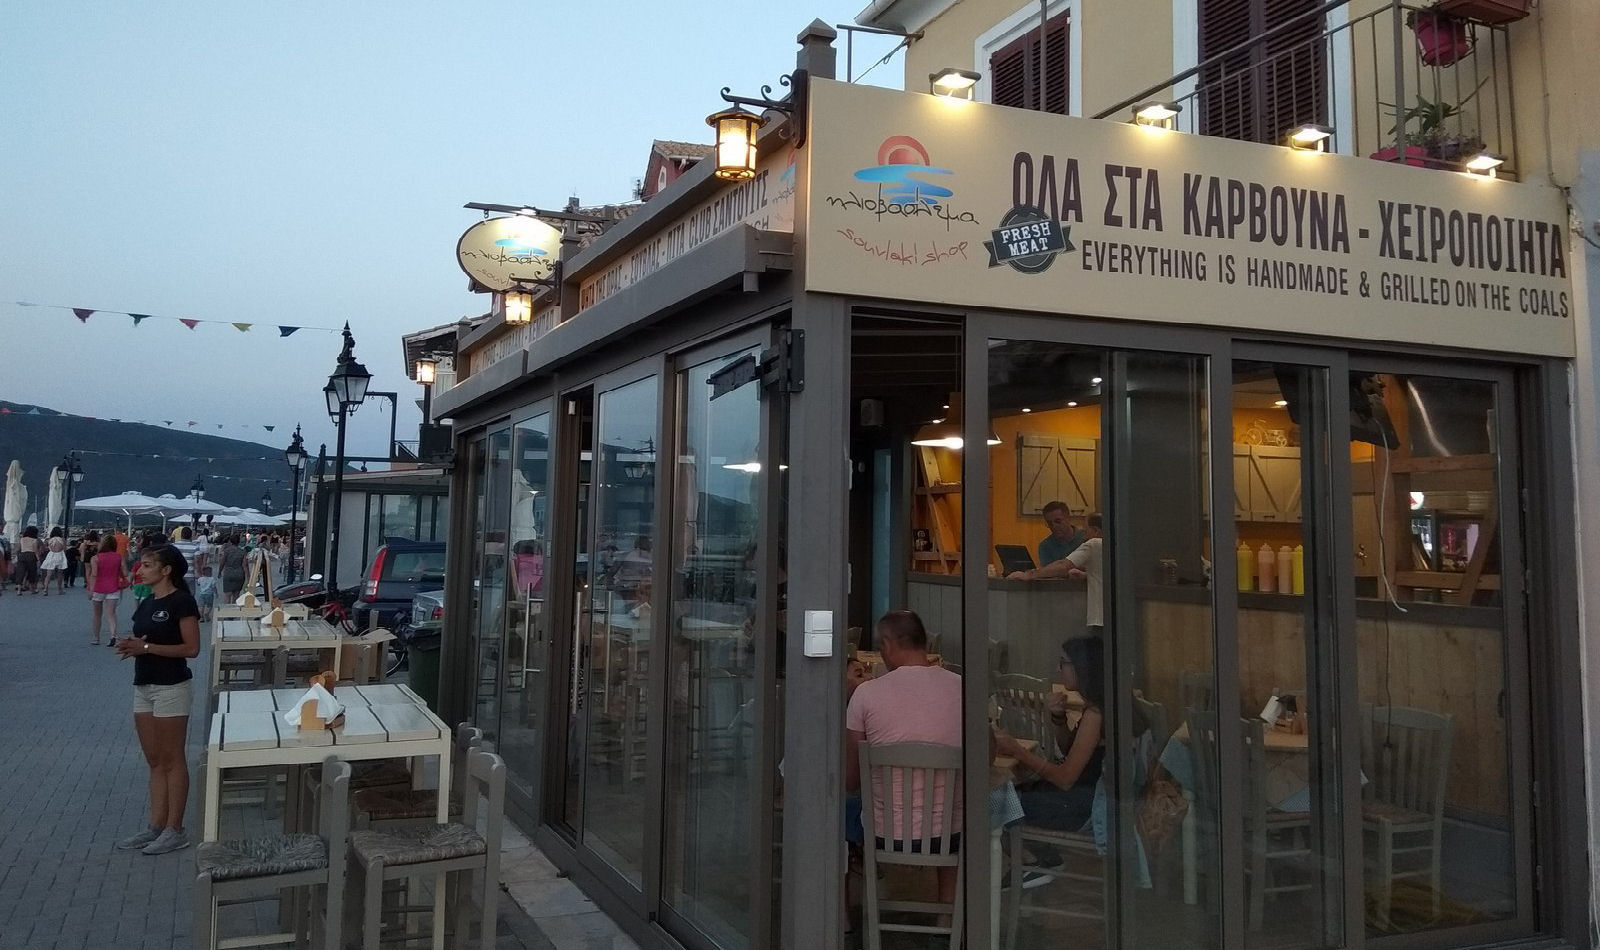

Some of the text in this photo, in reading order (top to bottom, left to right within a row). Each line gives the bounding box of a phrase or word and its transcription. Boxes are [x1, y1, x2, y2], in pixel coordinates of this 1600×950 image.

[1012, 151, 1084, 223] ΟΛΑ
[1104, 163, 1164, 232] ΣΤΑ
[1183, 172, 1351, 254] ΚΑΡΒΟΥΝΑ
[1378, 199, 1567, 279] ΧΕΙΡΟΠΟΙΗΤΑ
[1000, 221, 1052, 244] FRESH
[921, 240, 969, 266] shop
[1009, 236, 1050, 257] MEAT
[1082, 239, 1569, 318] EVERYTHING IS HANDMADE & GRILLED ON THE COALS
